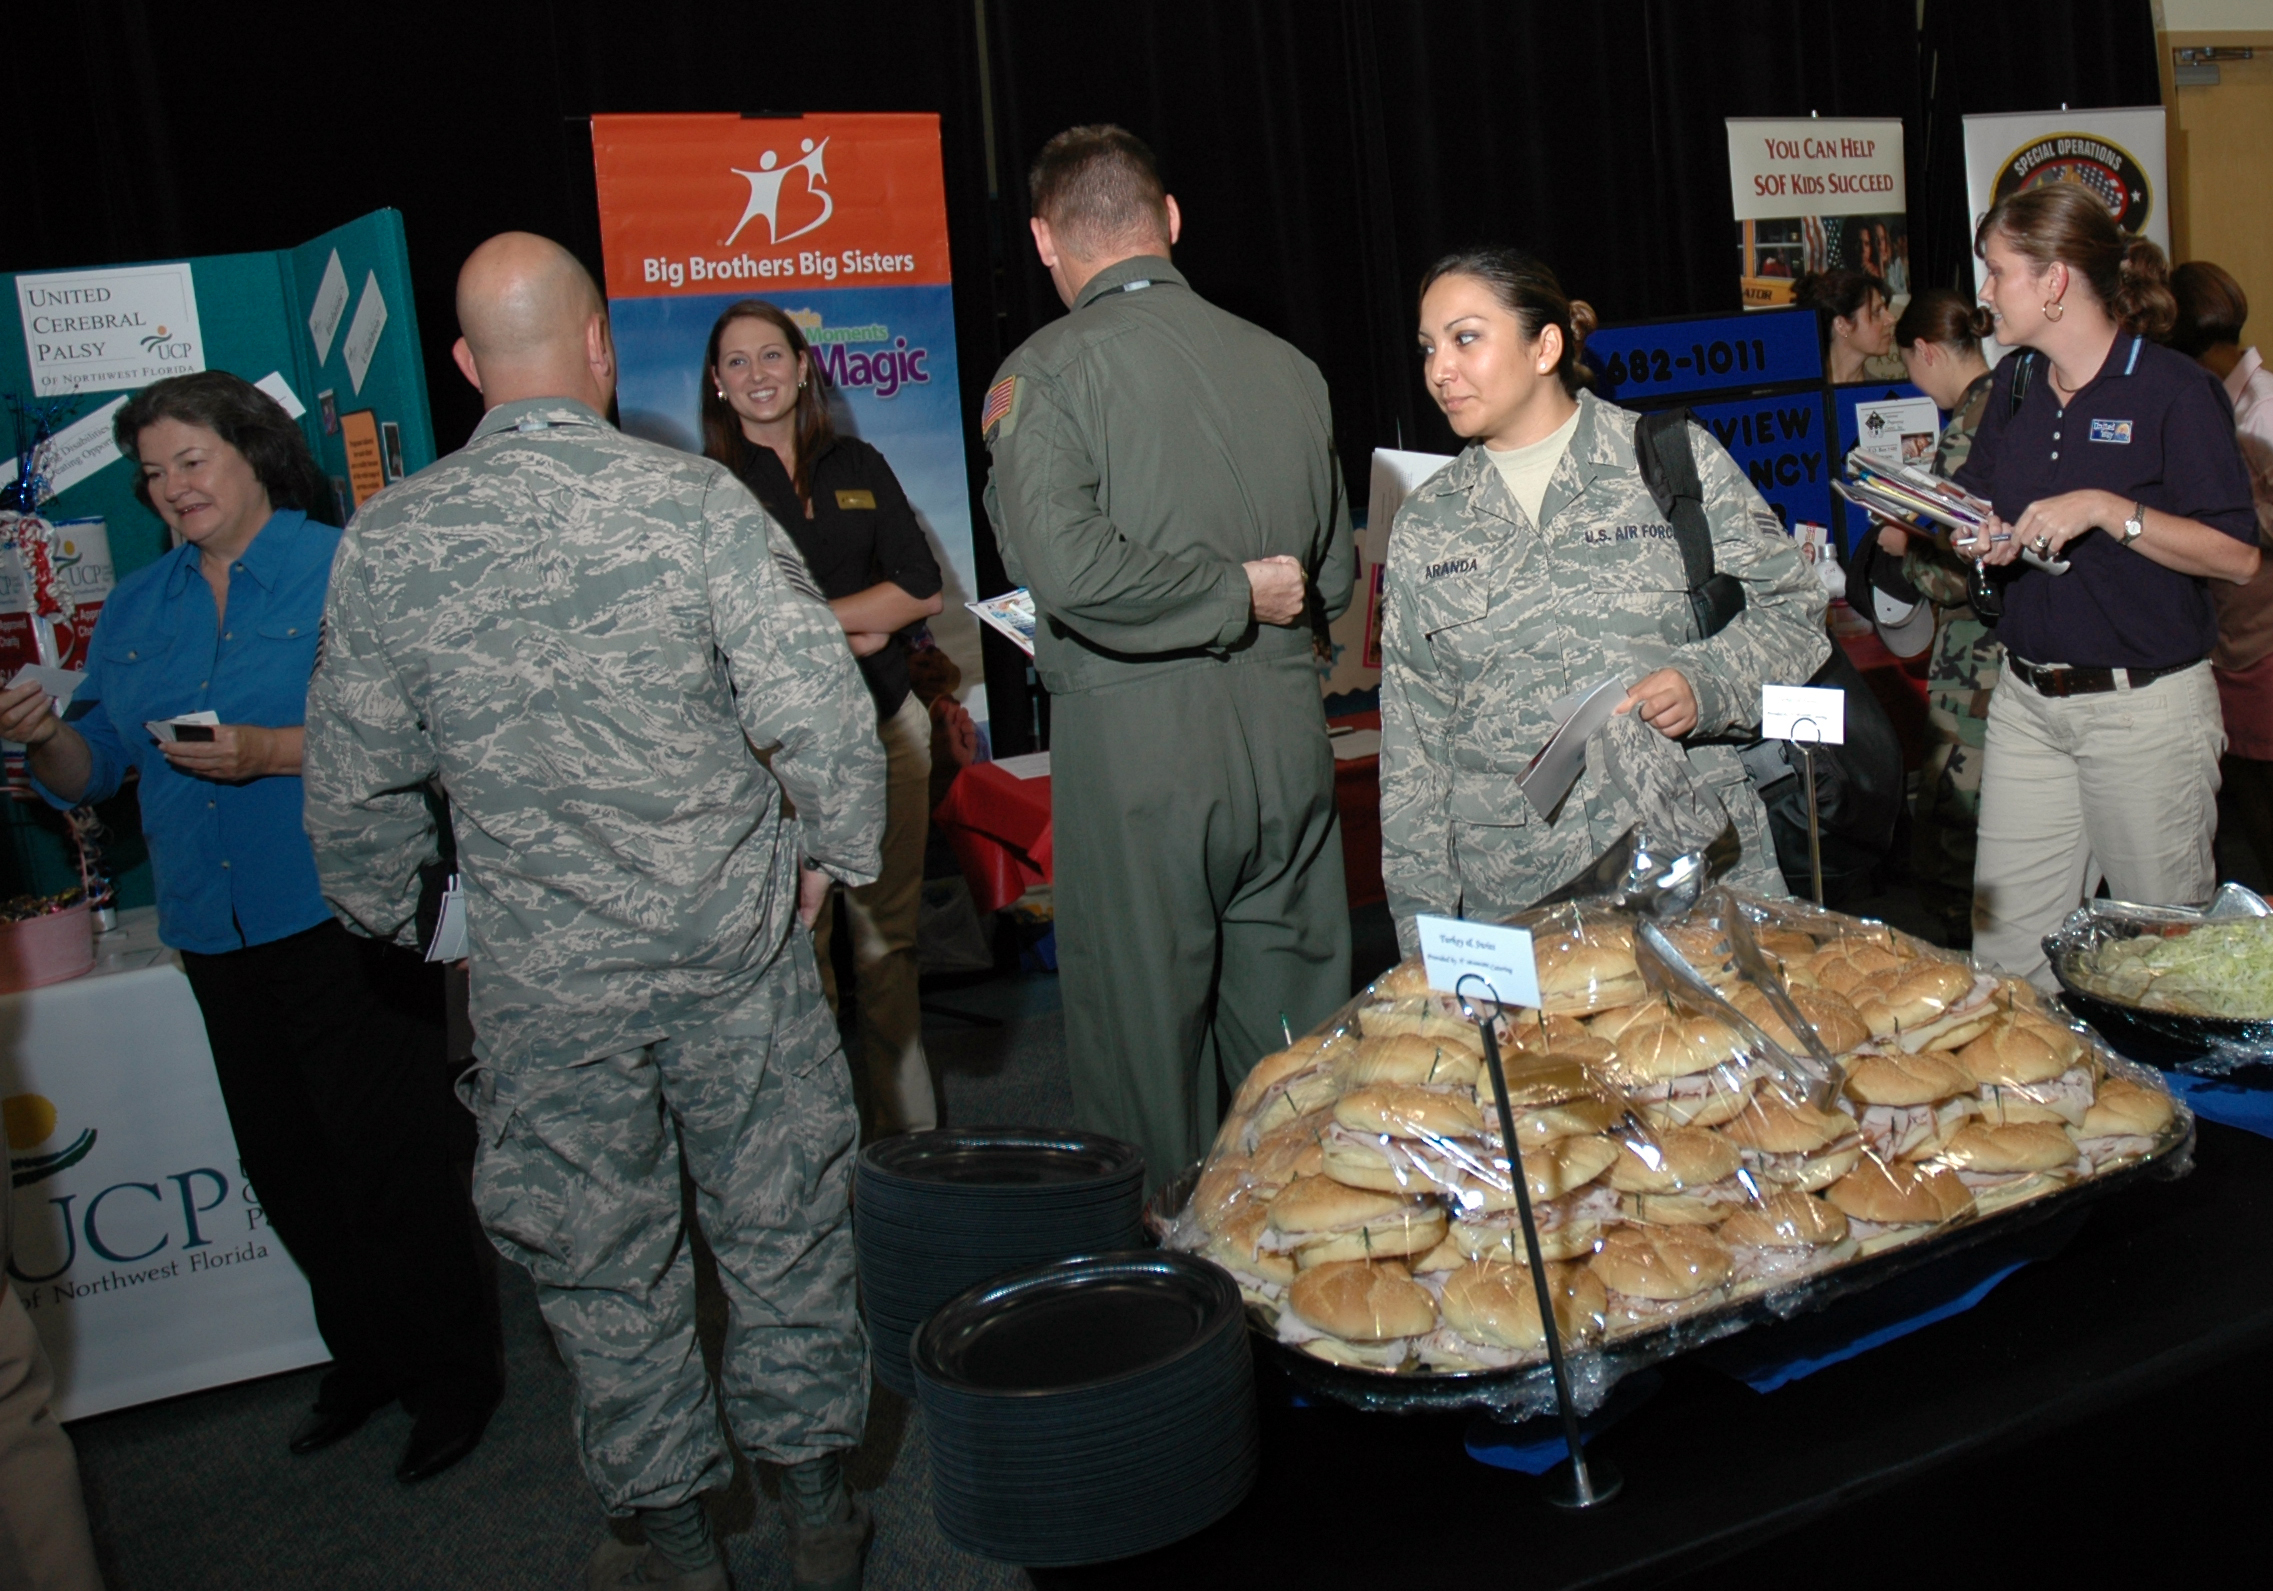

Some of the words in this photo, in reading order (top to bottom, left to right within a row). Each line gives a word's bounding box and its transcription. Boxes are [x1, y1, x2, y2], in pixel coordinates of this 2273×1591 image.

[1764, 138, 1800, 160] YOU
[1803, 137, 1838, 159] CAN
[1840, 137, 1876, 158] HELP
[2013, 142, 2056, 177] SPECIAL
[2057, 138, 2123, 171] OPERATIONS
[1754, 174, 1787, 197] SOF
[1791, 173, 1826, 195] KIDS
[1828, 172, 1894, 194] SUCCEED
[643, 256, 684, 288] Big
[689, 253, 795, 281] Brothers
[799, 250, 838, 281] Big
[842, 249, 915, 275] Sisters
[28, 287, 111, 308] UNITED
[33, 312, 147, 335] CEREBRAL
[805, 323, 889, 342] Moments
[37, 341, 106, 362] PALSY
[157, 342, 192, 361] UCP
[1606, 339, 1766, 386] 682-1011
[63, 369, 138, 385] NORTHWEST
[142, 364, 195, 378] FLORIDA
[809, 337, 929, 397] Magic
[60, 424, 110, 456] Disabilities
[1704, 406, 1812, 451] VIEW
[1749, 451, 1822, 490] NCY
[1584, 528, 1612, 544] U.S.
[1615, 525, 1639, 541] AIR
[1641, 523, 1677, 540] FORC
[69, 564, 101, 587] UCP
[1425, 558, 1478, 580] ARANDA
[6, 1167, 230, 1285] UCP
[53, 1260, 181, 1304] Northwest
[190, 1241, 269, 1274] Florida
